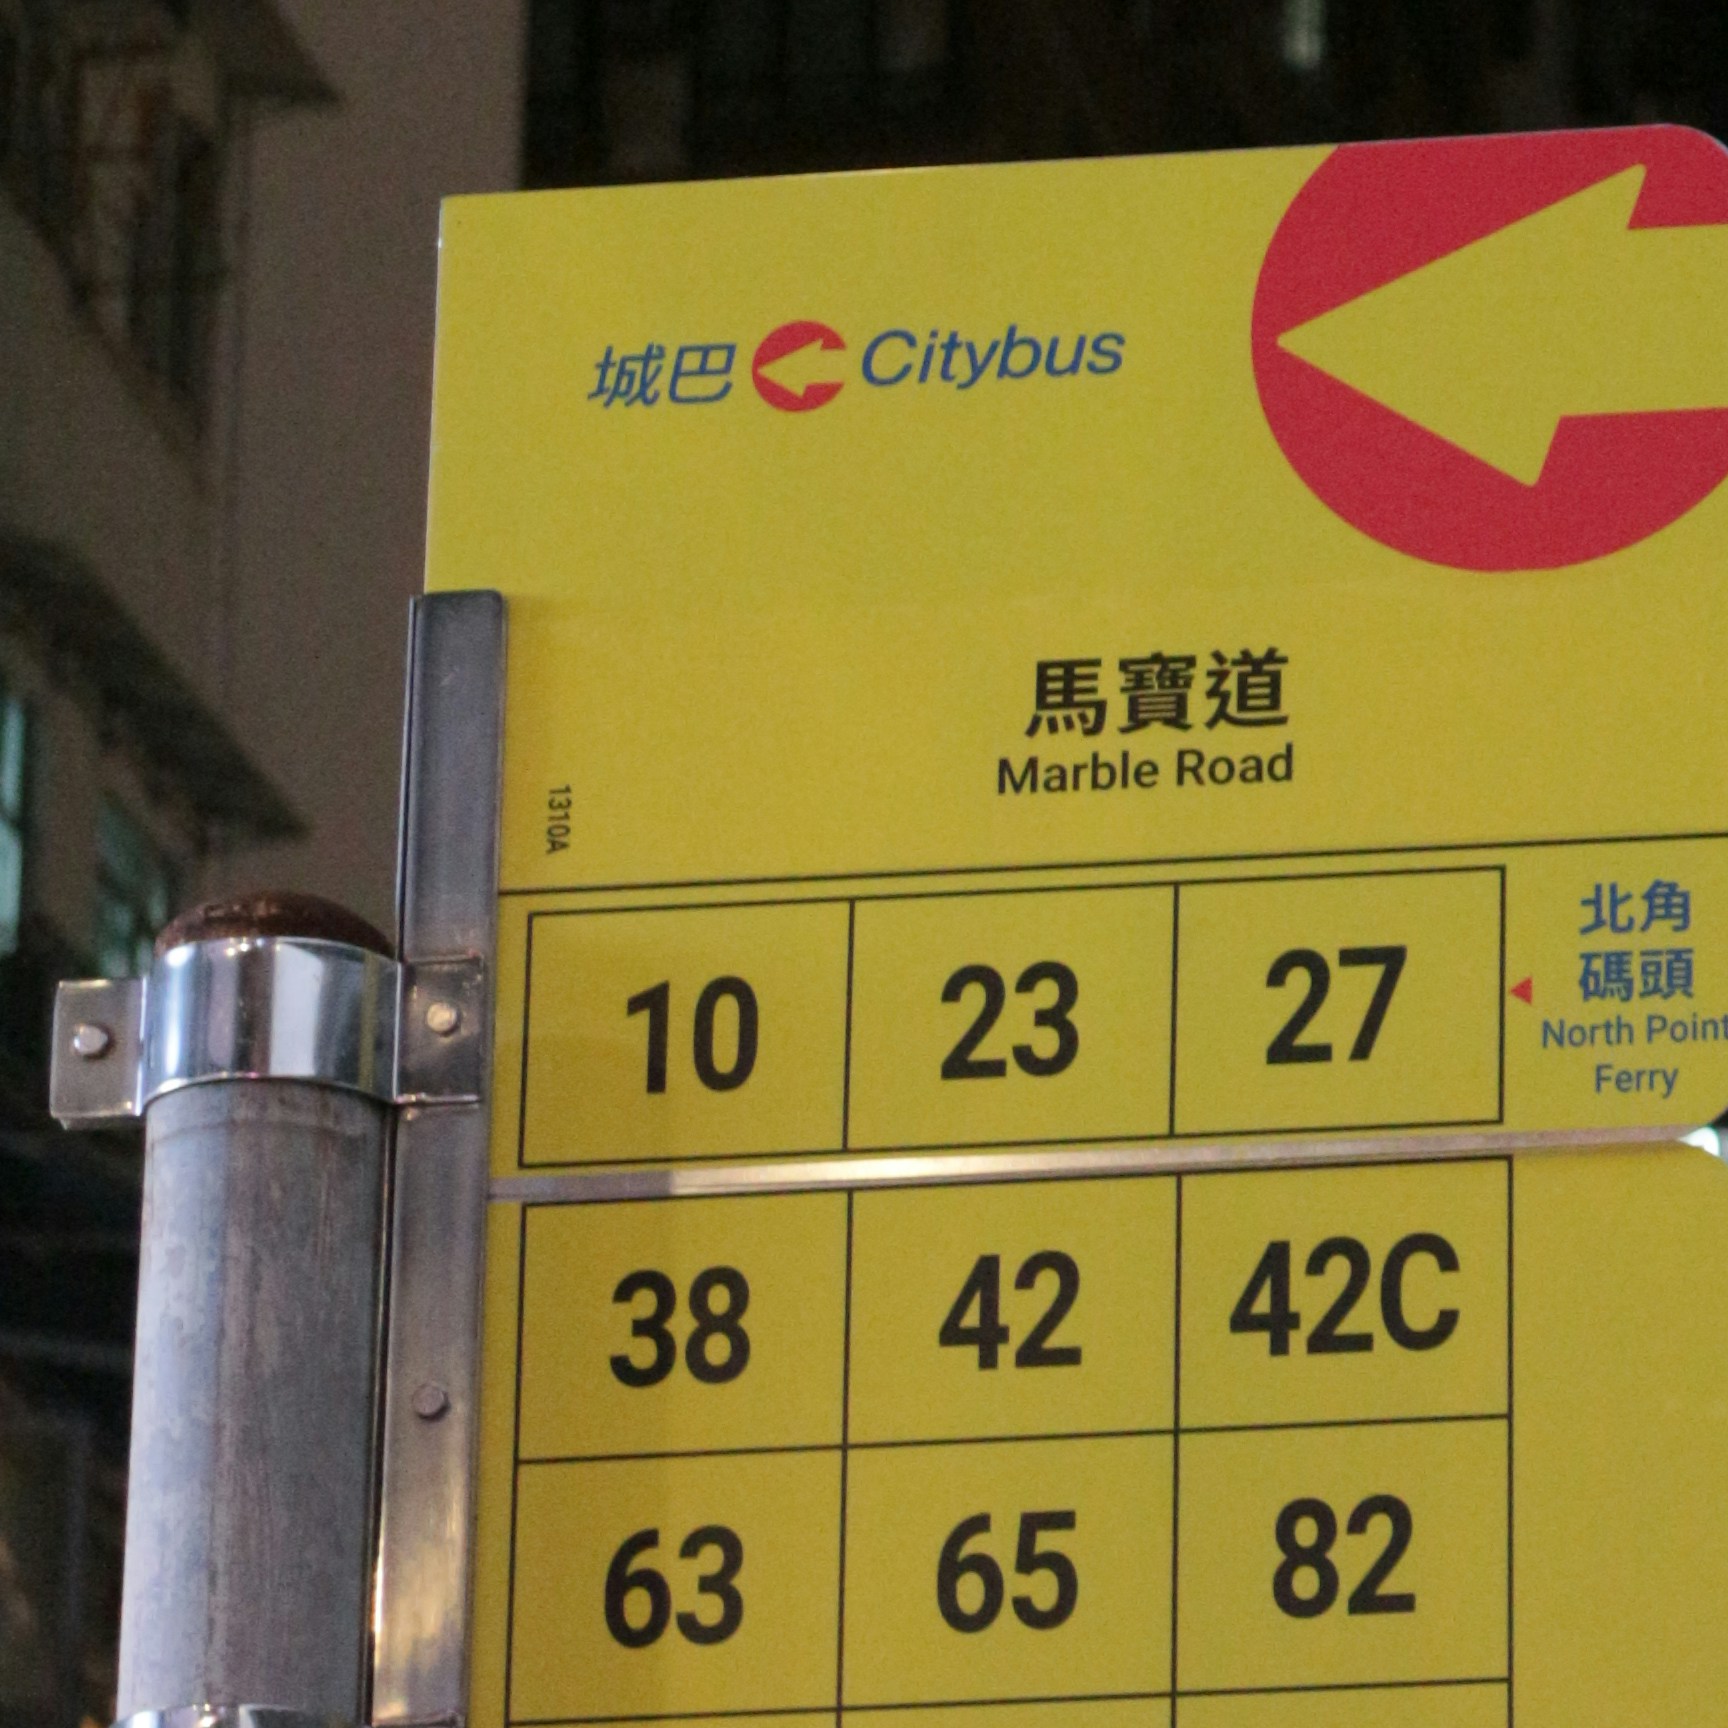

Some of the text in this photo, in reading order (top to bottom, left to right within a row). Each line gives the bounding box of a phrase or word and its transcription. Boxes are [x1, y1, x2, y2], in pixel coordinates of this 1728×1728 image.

[588, 325, 1125, 408] 城巴 Citybus
[1025, 647, 1293, 739] 馬寶道
[546, 785, 572, 854] 1310A
[998, 742, 1293, 794] Marble Road
[1580, 879, 1690, 935] 北角
[941, 961, 1078, 1080] 23
[1266, 945, 1407, 1065] 27
[1542, 1015, 1634, 1048] North
[1579, 948, 1693, 1002] 碼頭
[627, 976, 758, 1095] 10
[1595, 1064, 1678, 1099] Ferry
[609, 1266, 750, 1388] 38
[939, 1250, 1082, 1370] 42
[1229, 1233, 1459, 1357] 42C
[604, 1525, 743, 1649] 63
[937, 1510, 1078, 1634] 65
[1273, 1494, 1416, 1619] 82
